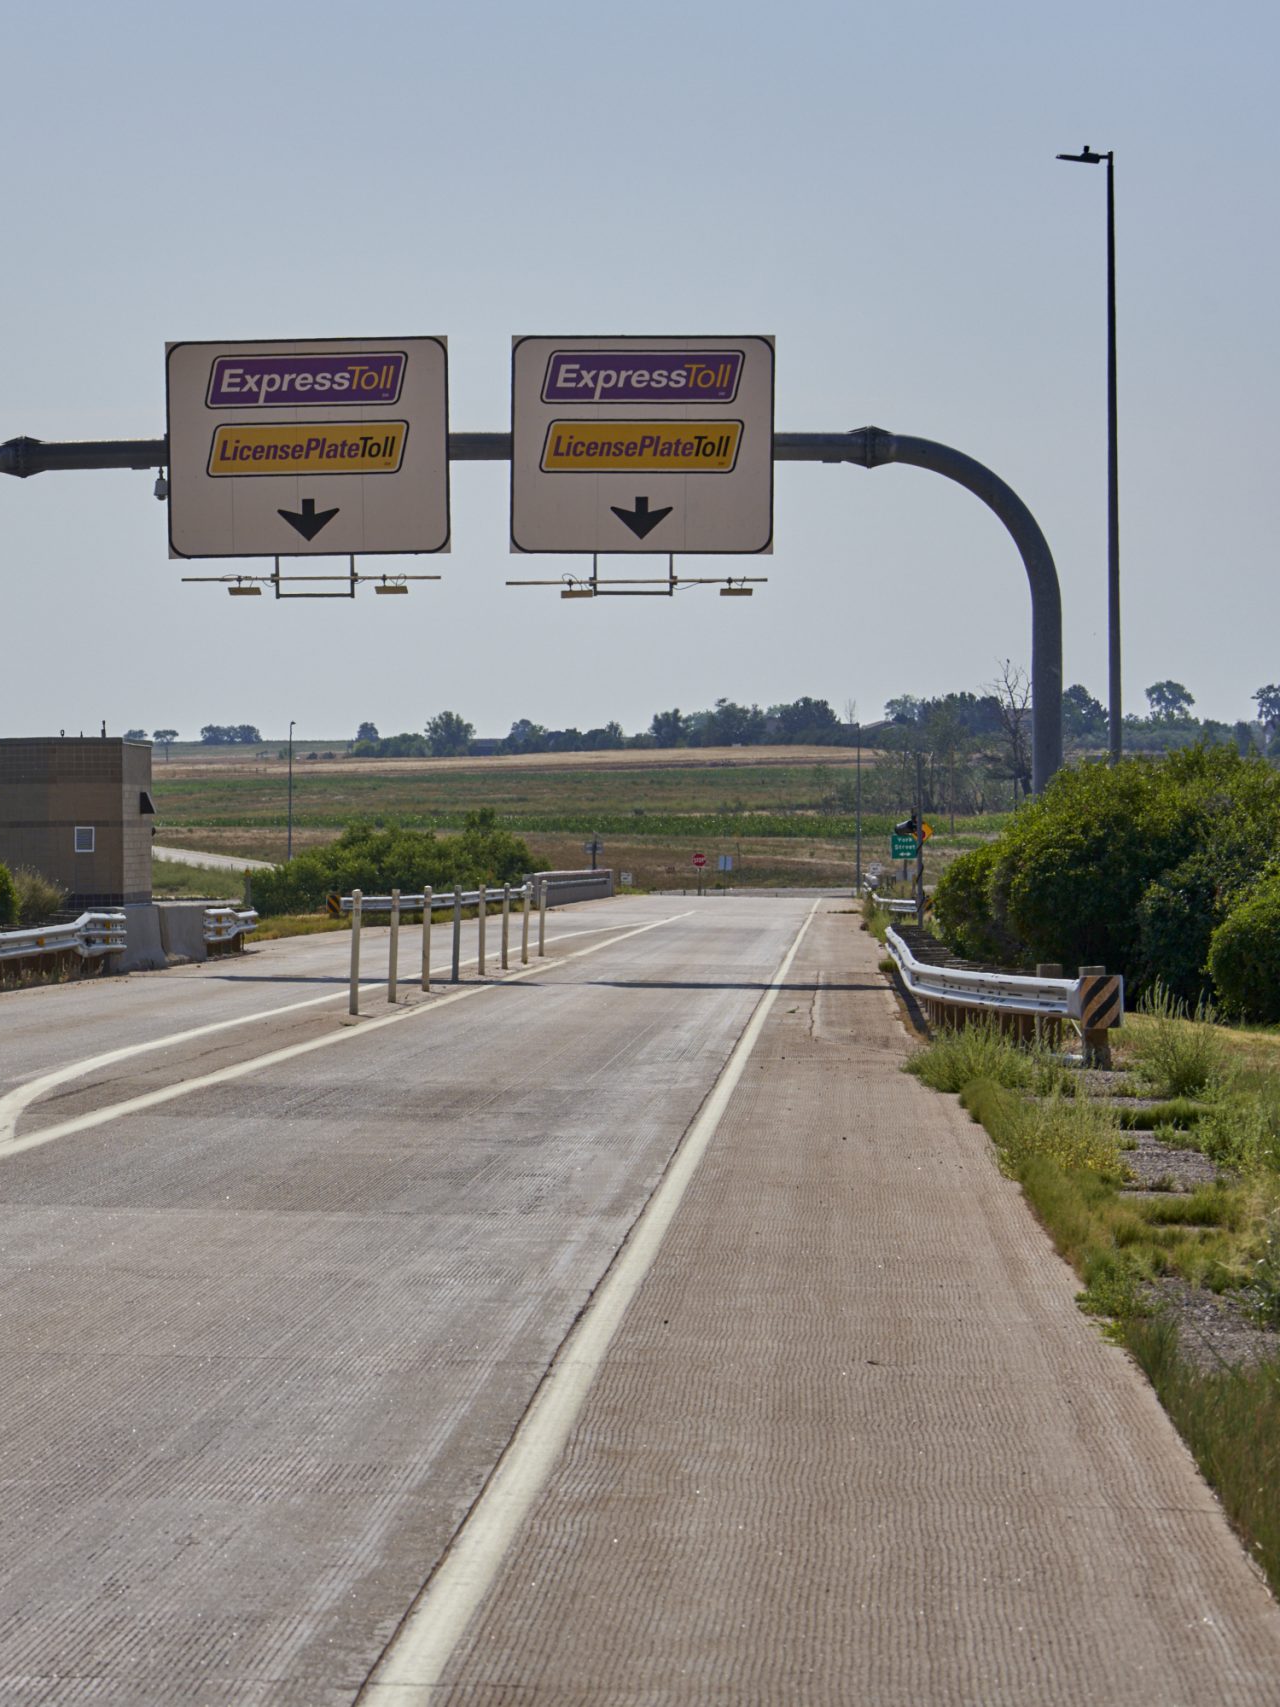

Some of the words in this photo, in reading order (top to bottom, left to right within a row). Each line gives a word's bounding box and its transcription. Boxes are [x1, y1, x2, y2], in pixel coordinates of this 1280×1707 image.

[220, 365, 395, 403] ExpressToll
[555, 363, 732, 400] ExpressToll
[220, 436, 396, 461] LicensePlateToll
[552, 435, 731, 457] LicensePlateToll
